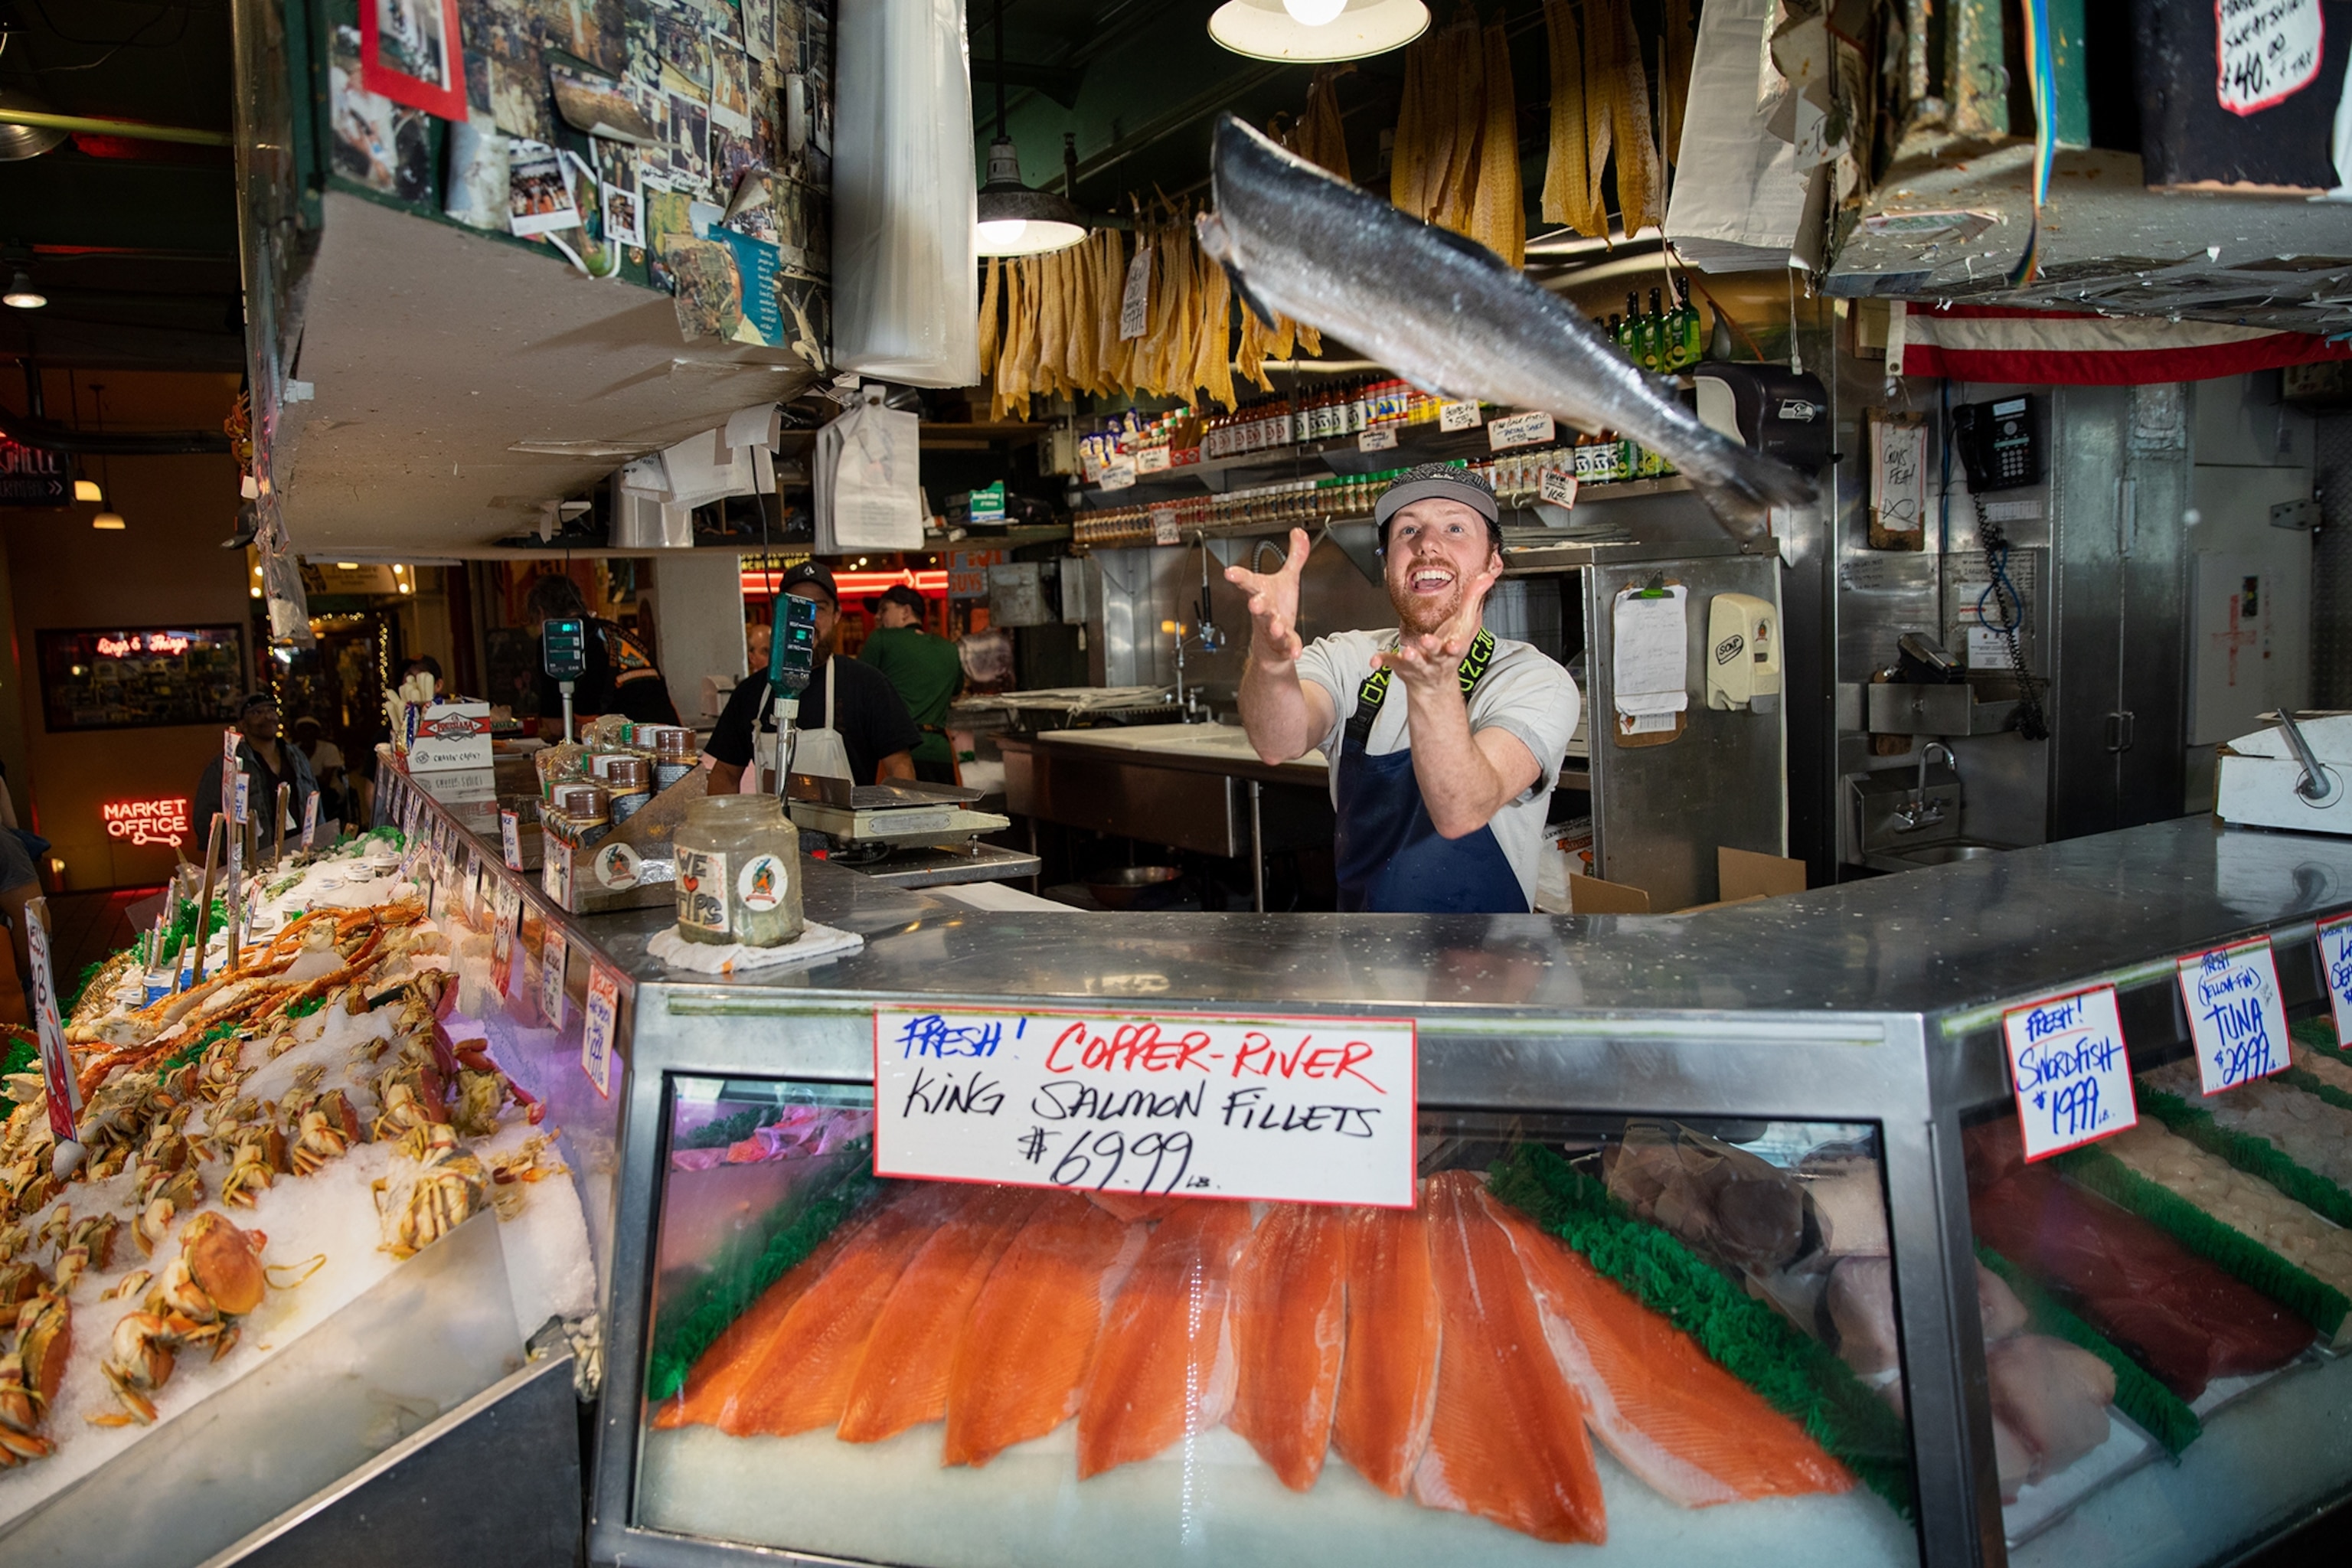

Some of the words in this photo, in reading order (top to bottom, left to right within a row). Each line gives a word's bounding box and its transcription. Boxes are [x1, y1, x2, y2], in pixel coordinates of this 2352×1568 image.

[1718, 639, 1742, 656] SOAP
[437, 720, 474, 733] LOUISIANA
[104, 799, 187, 820] MARKET
[107, 816, 188, 837] OFFICE
[676, 848, 708, 877] WE
[676, 890, 724, 926] TIPS
[2203, 997, 2263, 1046] TUNA
[2017, 1036, 2123, 1092] SWORDFISH
[903, 1067, 1005, 1118] KING
[1032, 1080, 1206, 1120] SALMON
[1221, 1087, 1381, 1138] FILLETS
[1018, 1125, 1194, 1197] $69.99
